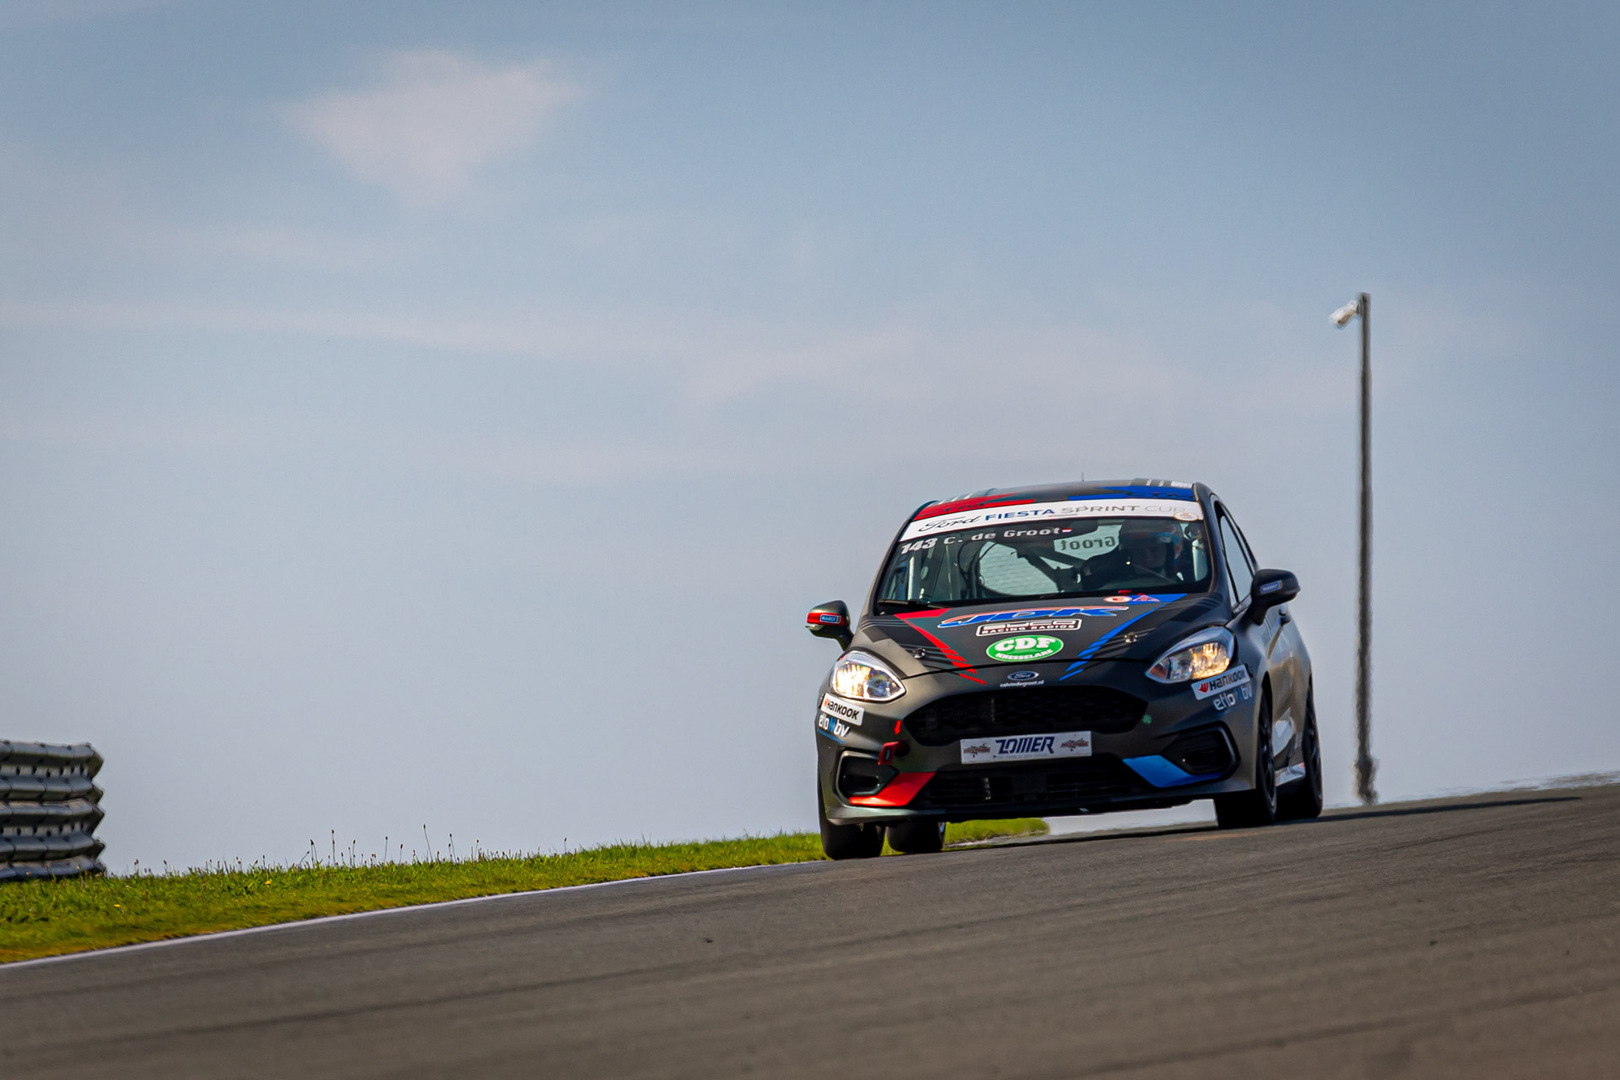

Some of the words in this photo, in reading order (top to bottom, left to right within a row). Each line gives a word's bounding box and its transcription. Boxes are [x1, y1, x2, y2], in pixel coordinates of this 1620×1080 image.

[918, 514, 982, 533] Ford
[985, 508, 1056, 522] FIESTA
[1061, 504, 1141, 514] SPRINT
[1144, 504, 1186, 514] CUP
[900, 537, 938, 555] 143
[944, 536, 963, 545] C.
[971, 532, 997, 541] de
[1003, 527, 1061, 538] Groot
[981, 626, 1026, 635] RACING
[994, 637, 1056, 651] CDF
[995, 736, 1055, 754] ZOMER
